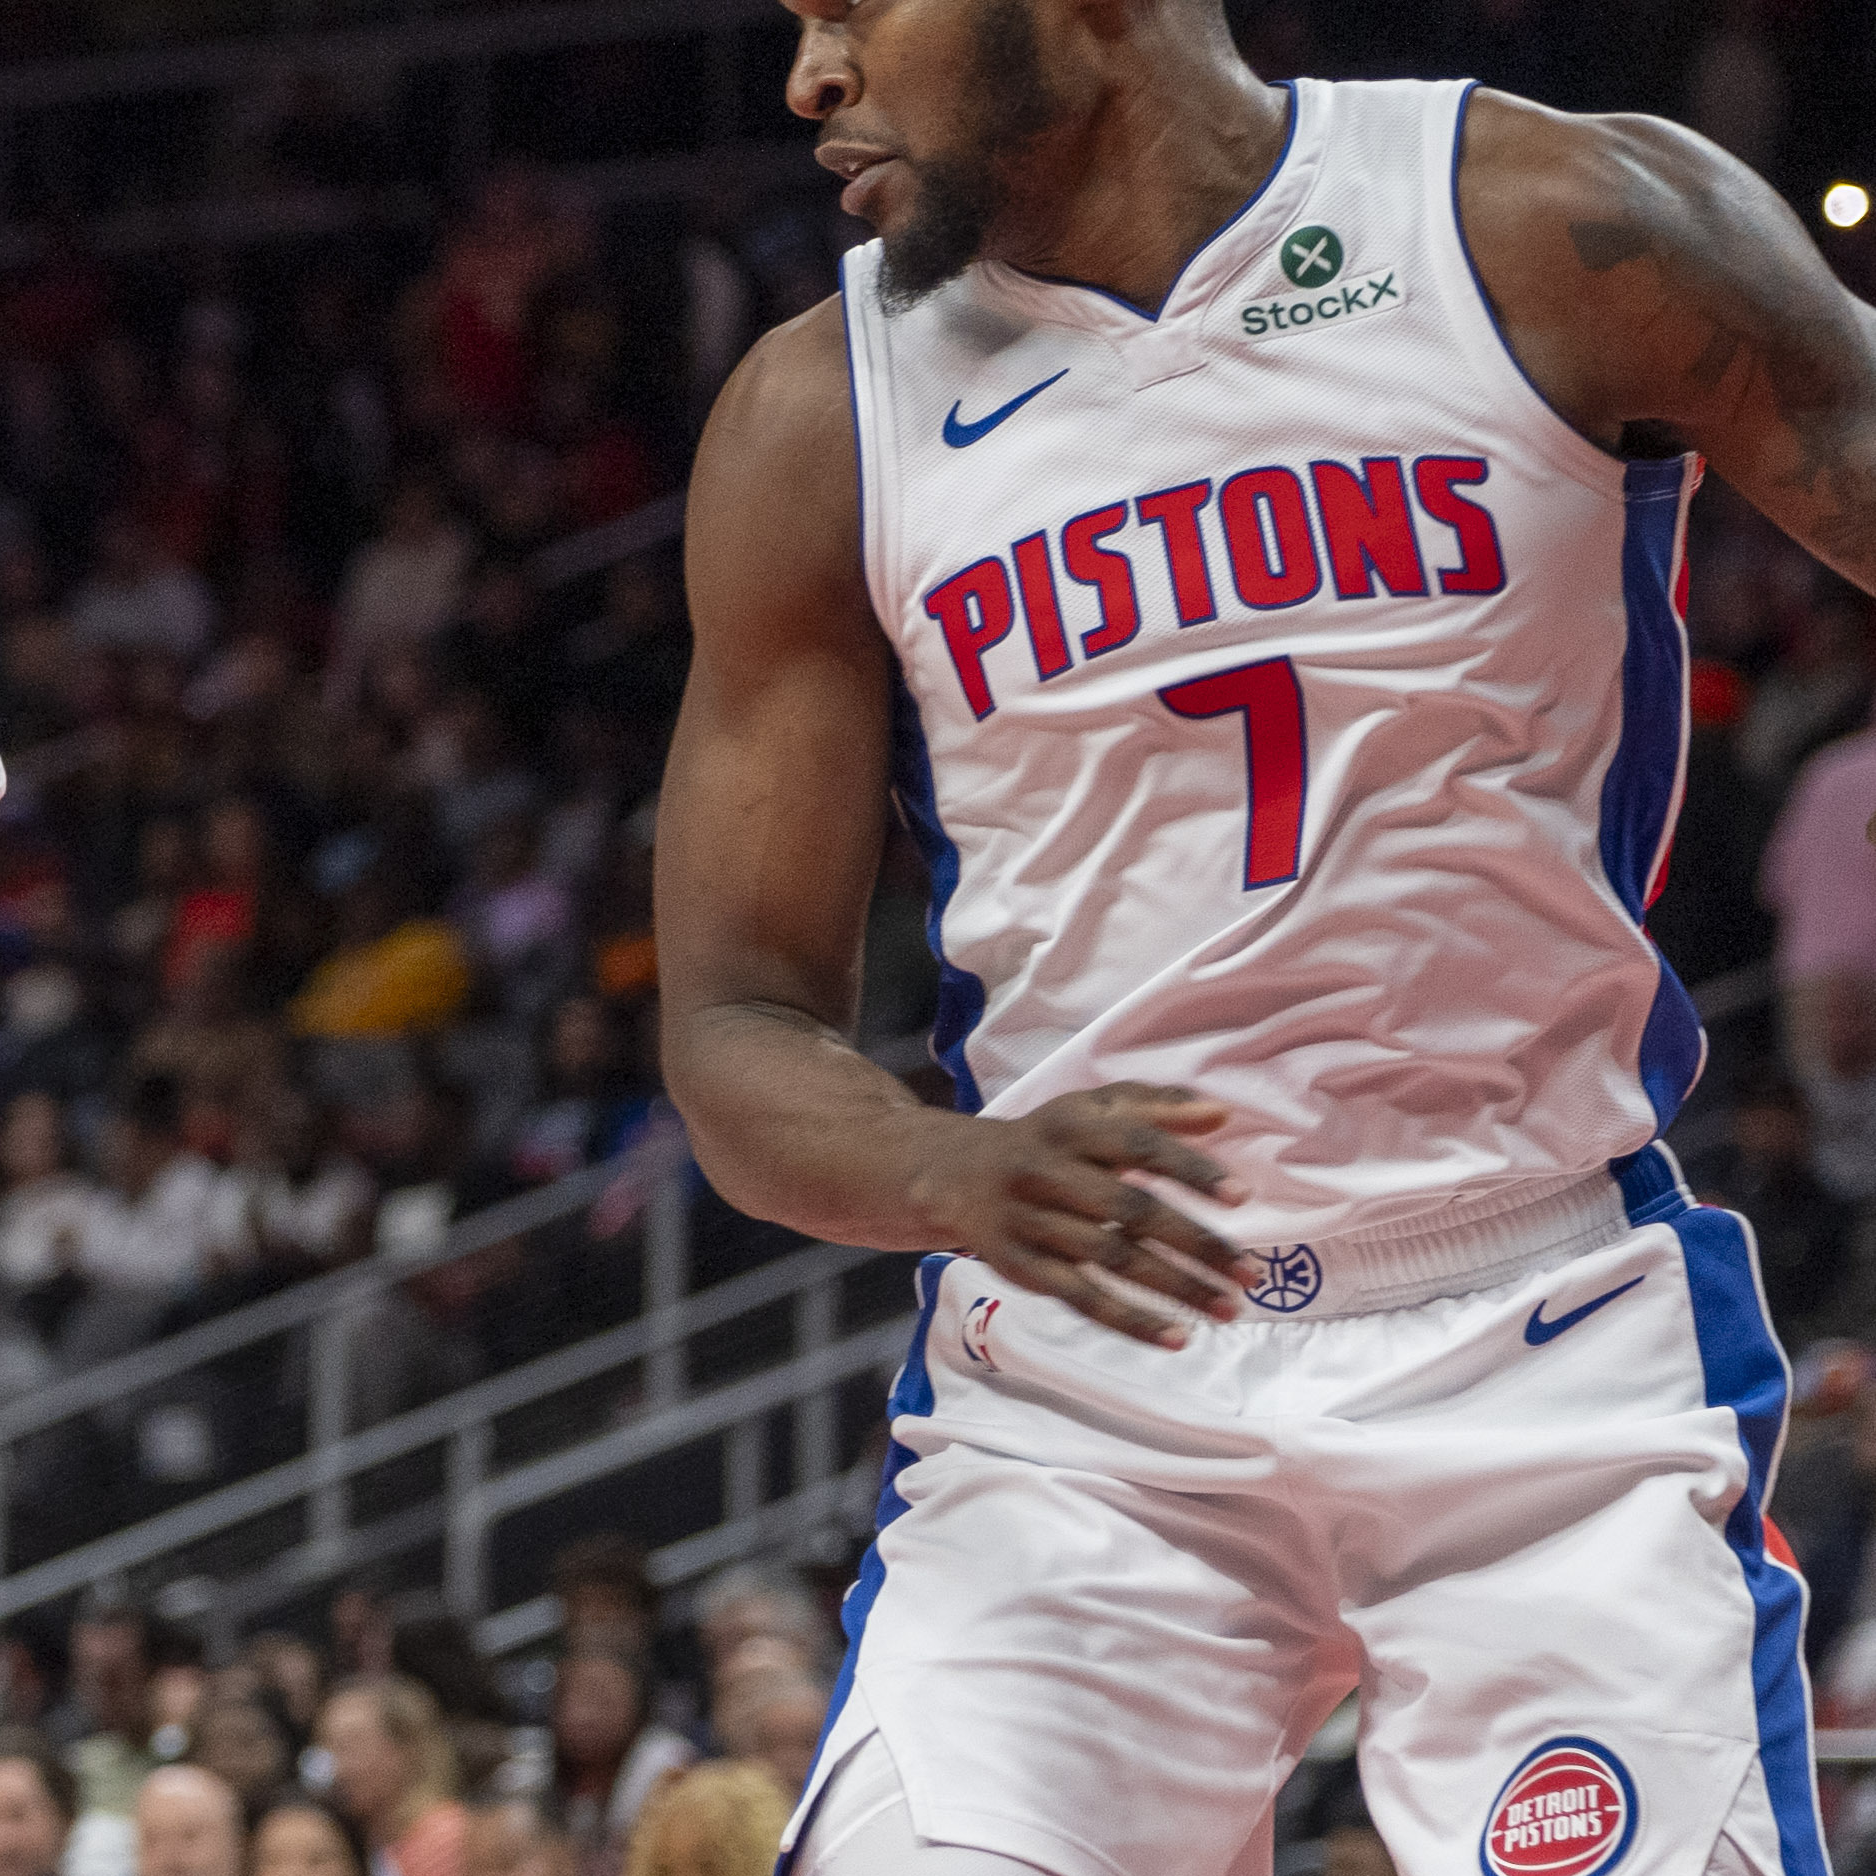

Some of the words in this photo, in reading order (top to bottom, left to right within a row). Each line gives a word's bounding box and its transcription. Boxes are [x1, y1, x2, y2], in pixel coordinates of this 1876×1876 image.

[1242, 272, 1399, 335] StockX
[925, 455, 1507, 722] PISTONS
[1157, 655, 1308, 892] 7
[1504, 1811, 1603, 1853] PISTONS
[1506, 1785, 1600, 1827] DETROIT
